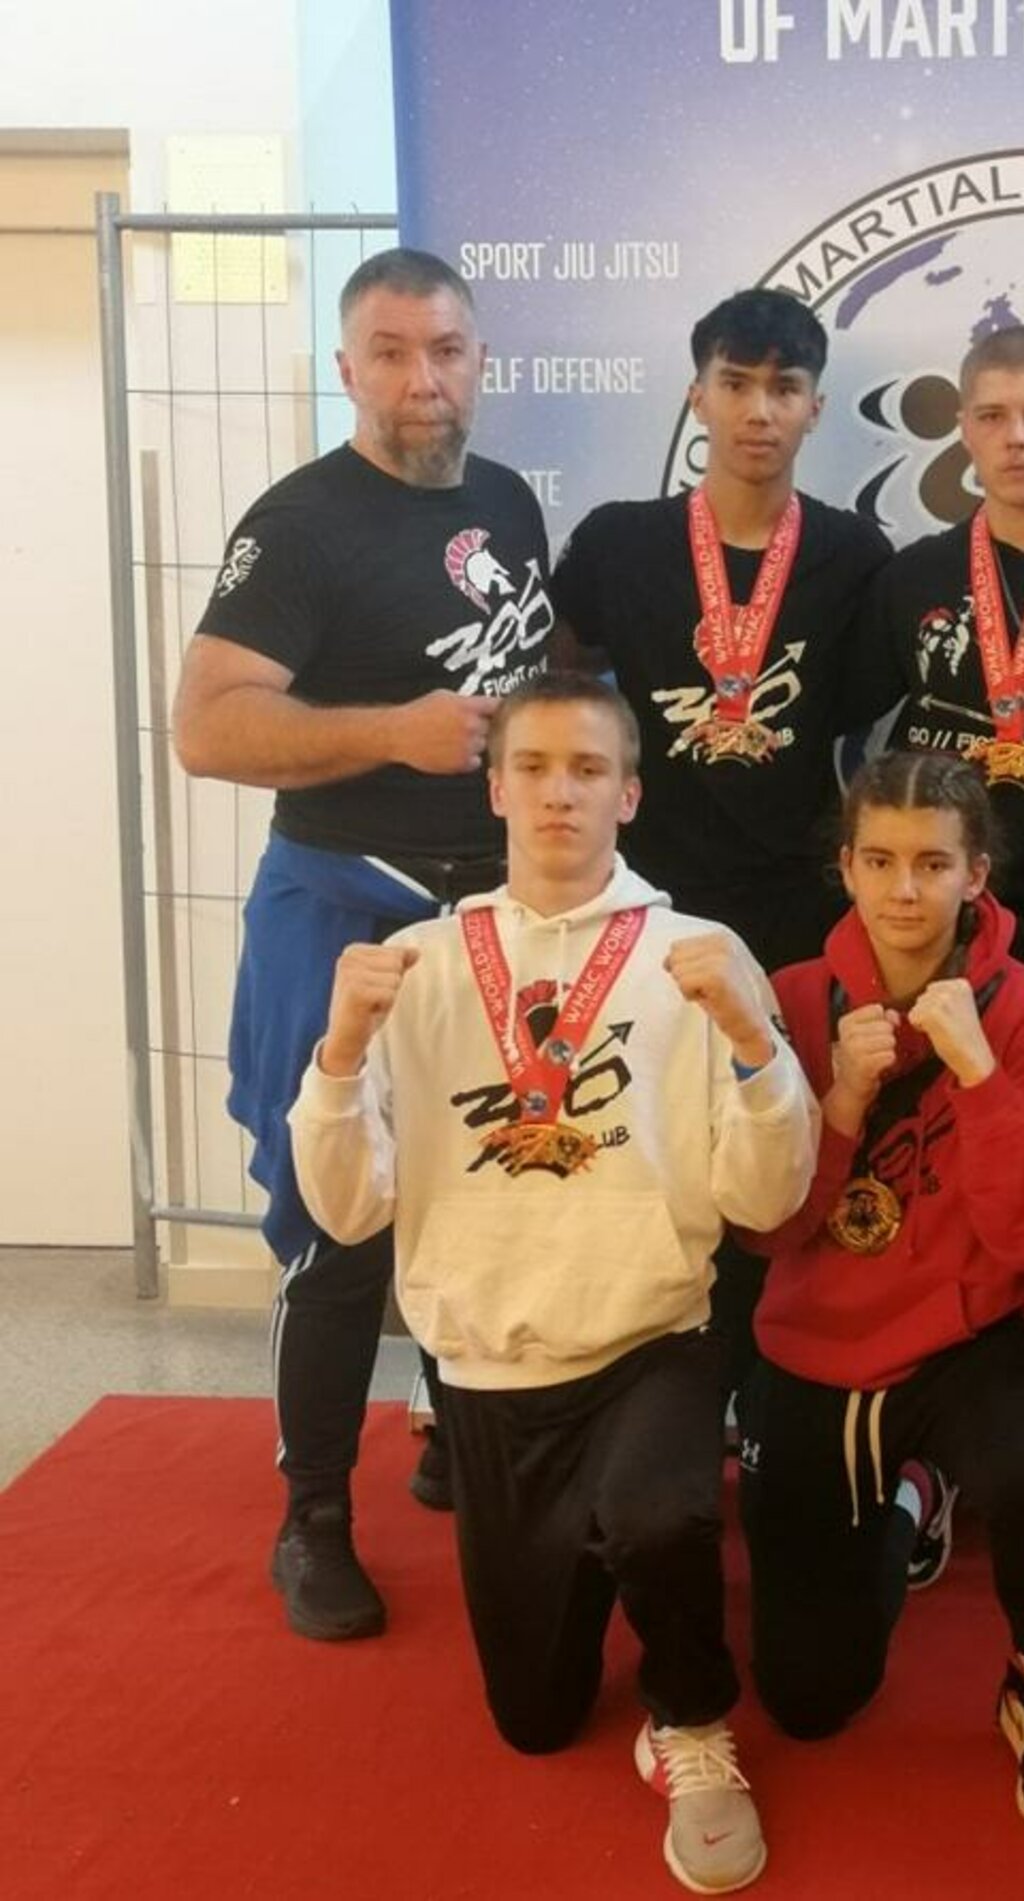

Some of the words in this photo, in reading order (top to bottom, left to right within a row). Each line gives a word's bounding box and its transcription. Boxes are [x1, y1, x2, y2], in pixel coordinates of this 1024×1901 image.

[719, 0, 796, 63] OF
[775, 165, 1022, 302] MARTIAL
[460, 242, 546, 281] SPORT
[553, 242, 596, 281] JIU
[604, 241, 681, 281] JITSU
[480, 357, 524, 394] ELF
[532, 357, 647, 394] DEFENSE
[908, 726, 930, 746] GO
